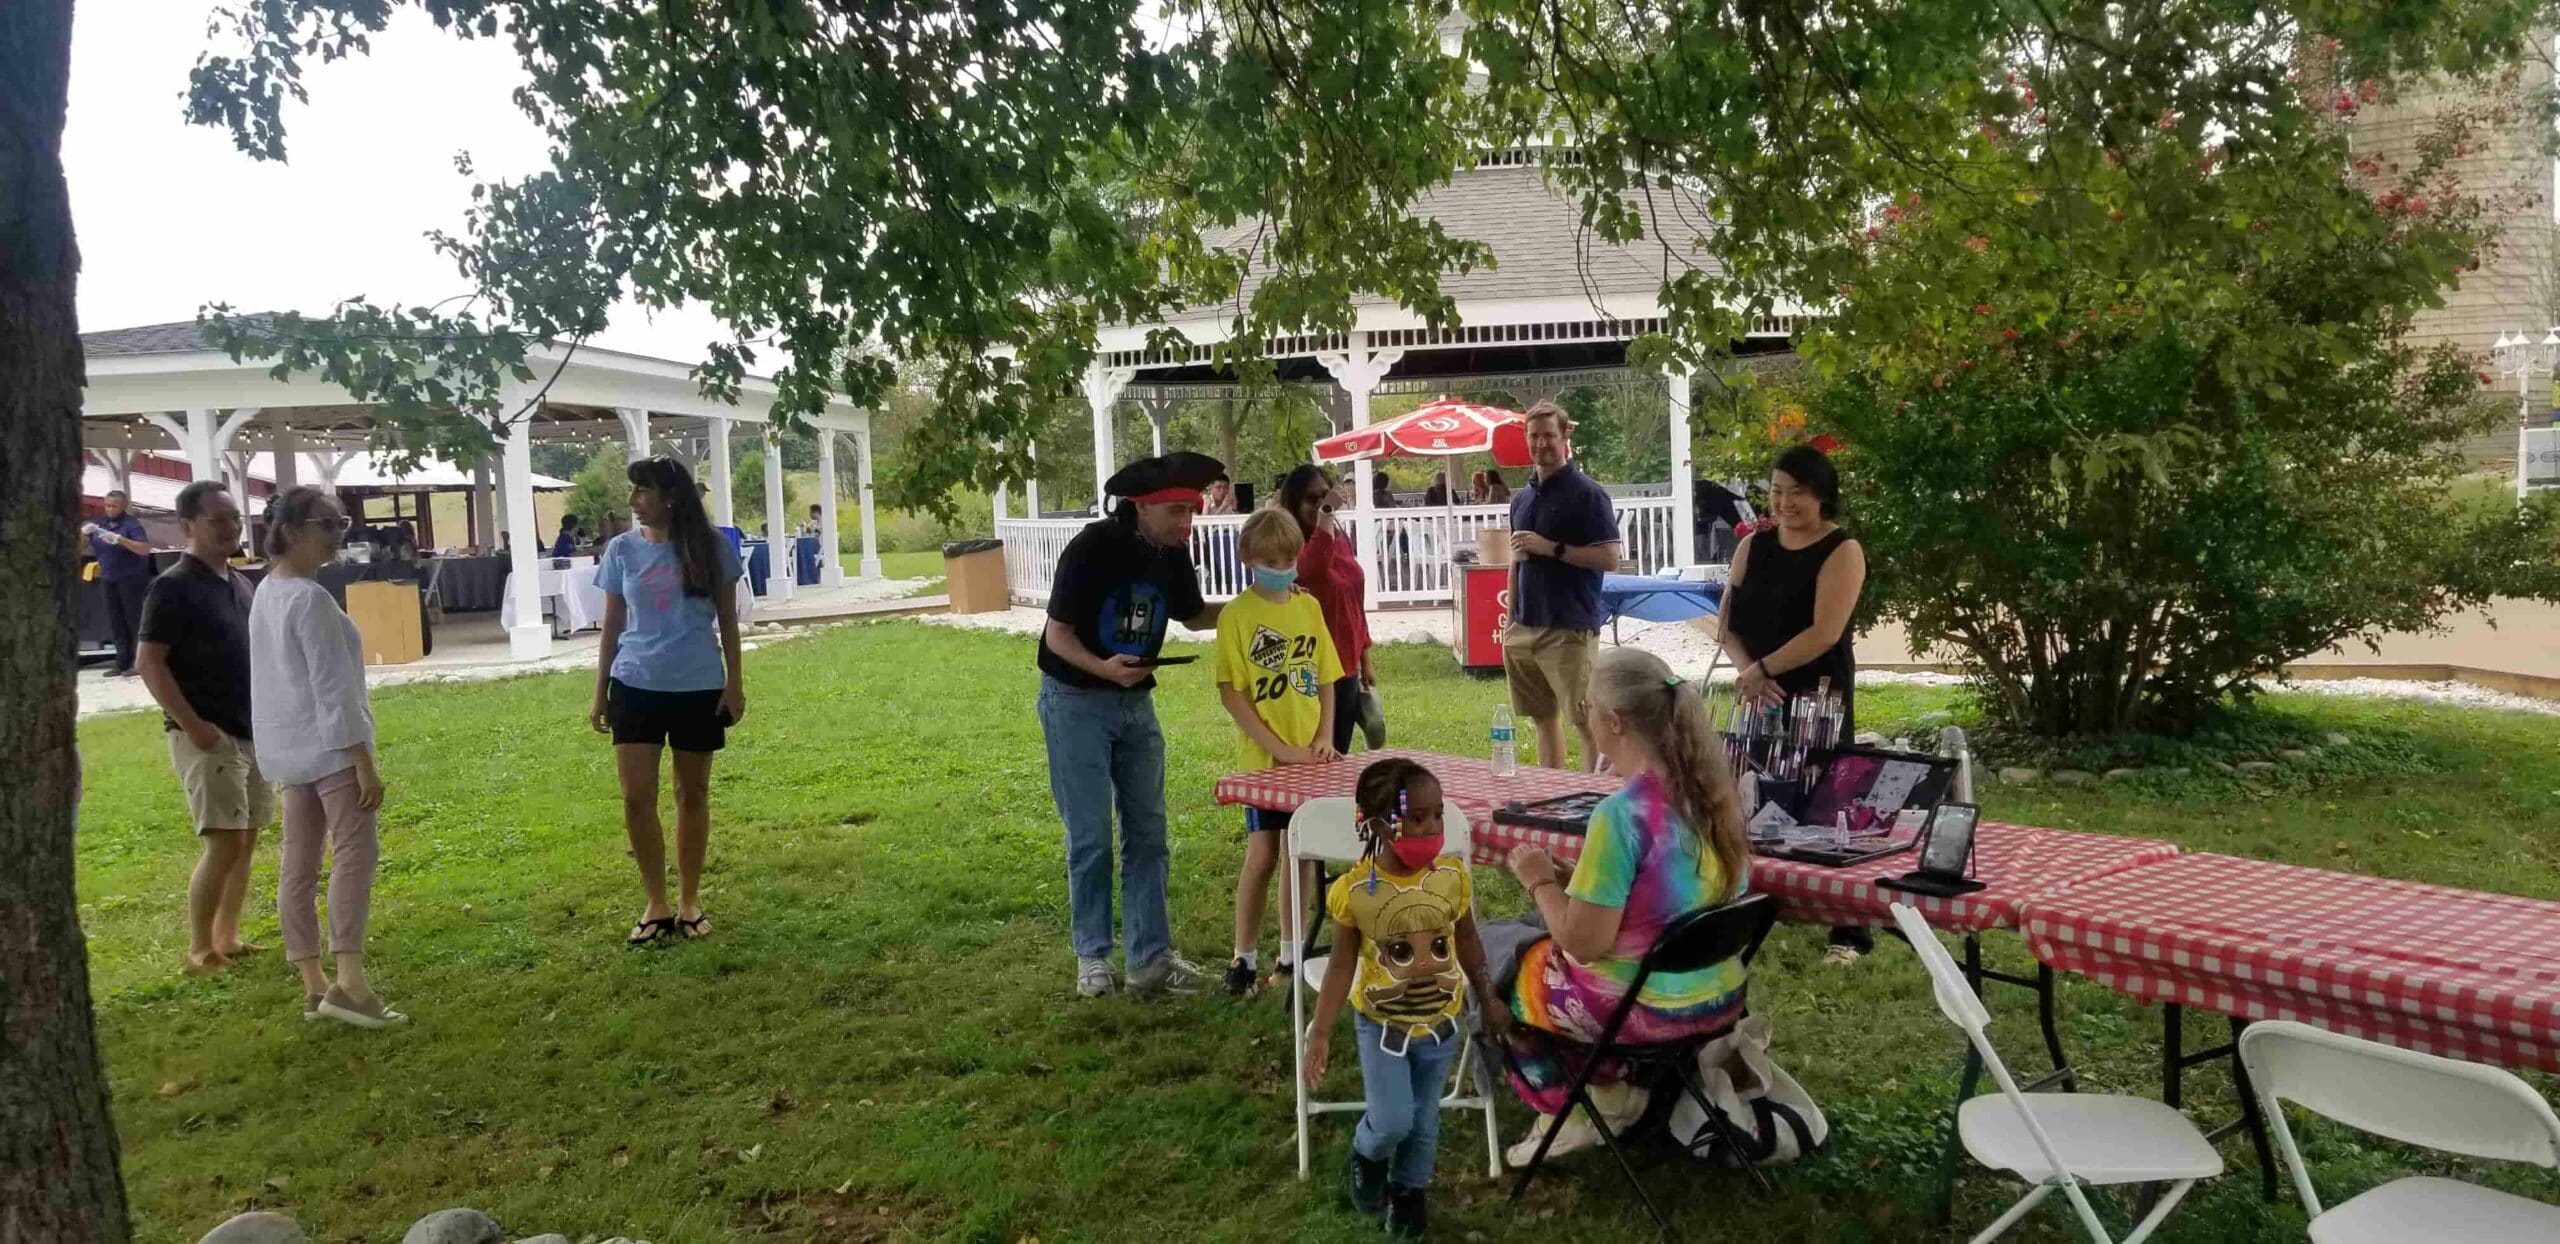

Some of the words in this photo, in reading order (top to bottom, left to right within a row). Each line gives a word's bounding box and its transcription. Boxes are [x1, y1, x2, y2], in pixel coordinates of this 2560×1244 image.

[1263, 652, 1285, 666] CAMP
[1291, 634, 1317, 659] 20
[1254, 673, 1288, 703] 20
